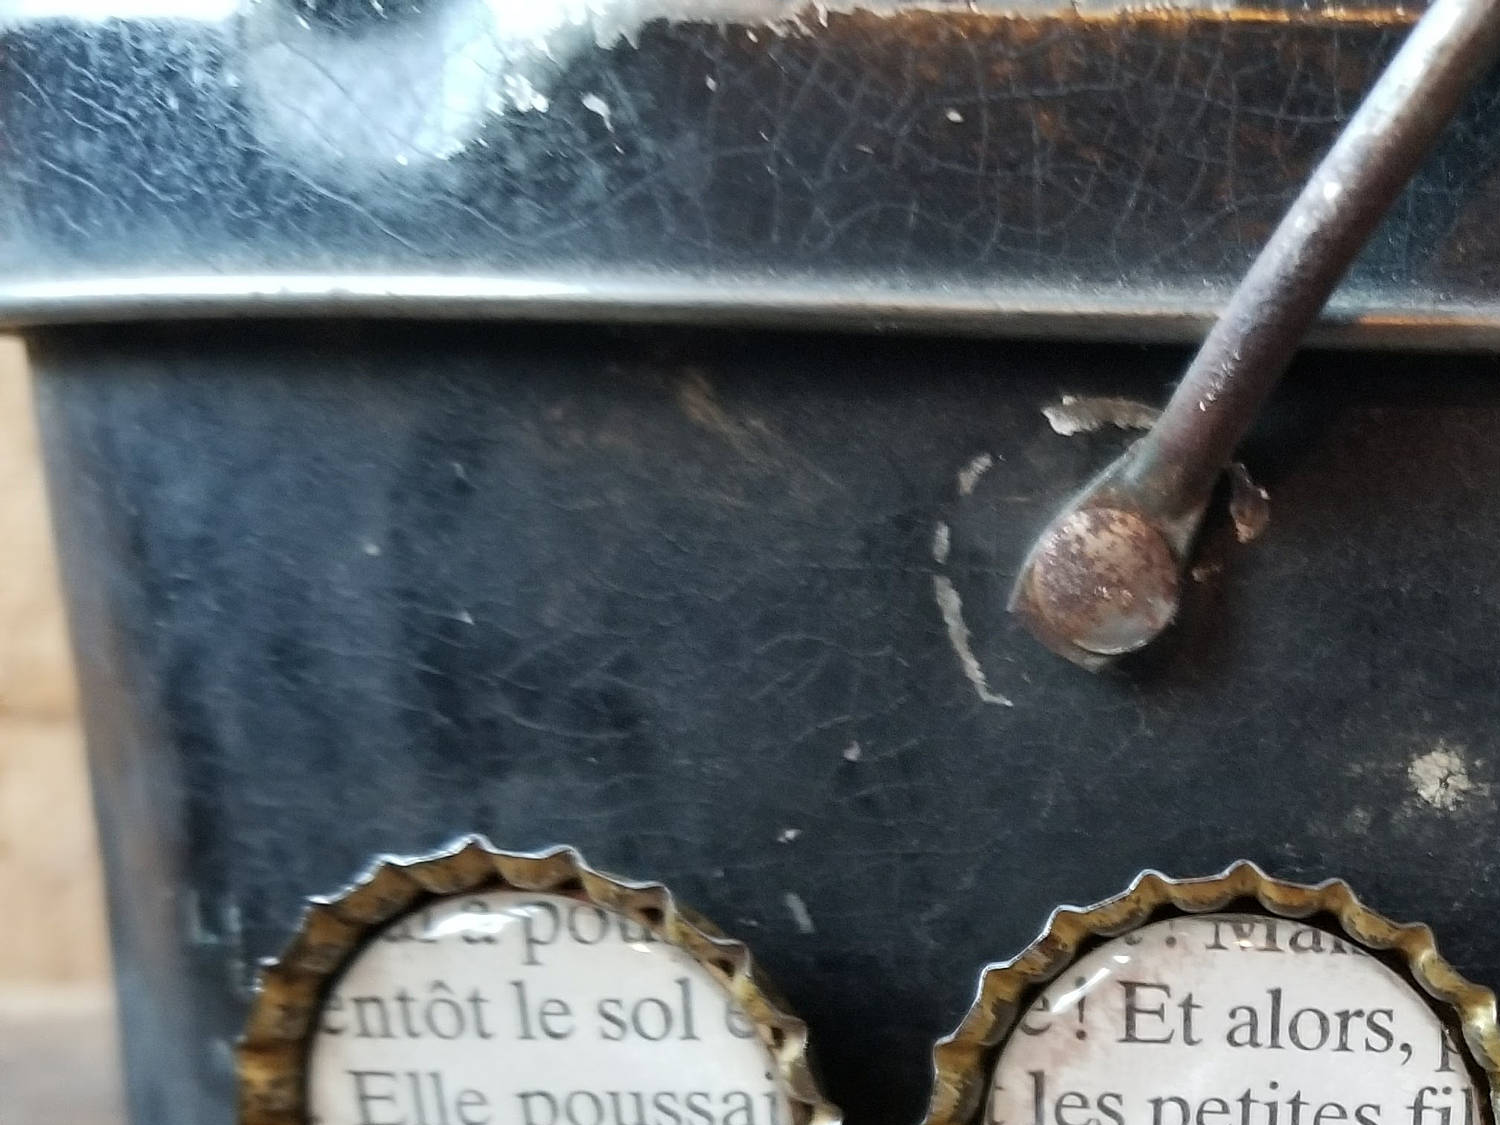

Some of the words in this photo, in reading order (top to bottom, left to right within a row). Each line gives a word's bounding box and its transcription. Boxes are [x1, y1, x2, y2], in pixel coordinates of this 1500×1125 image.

[321, 981, 494, 1041] entôt
[511, 981, 574, 1041] le
[599, 977, 702, 1042] sol
[1117, 980, 1203, 1047] Et
[1226, 986, 1413, 1065] alors,
